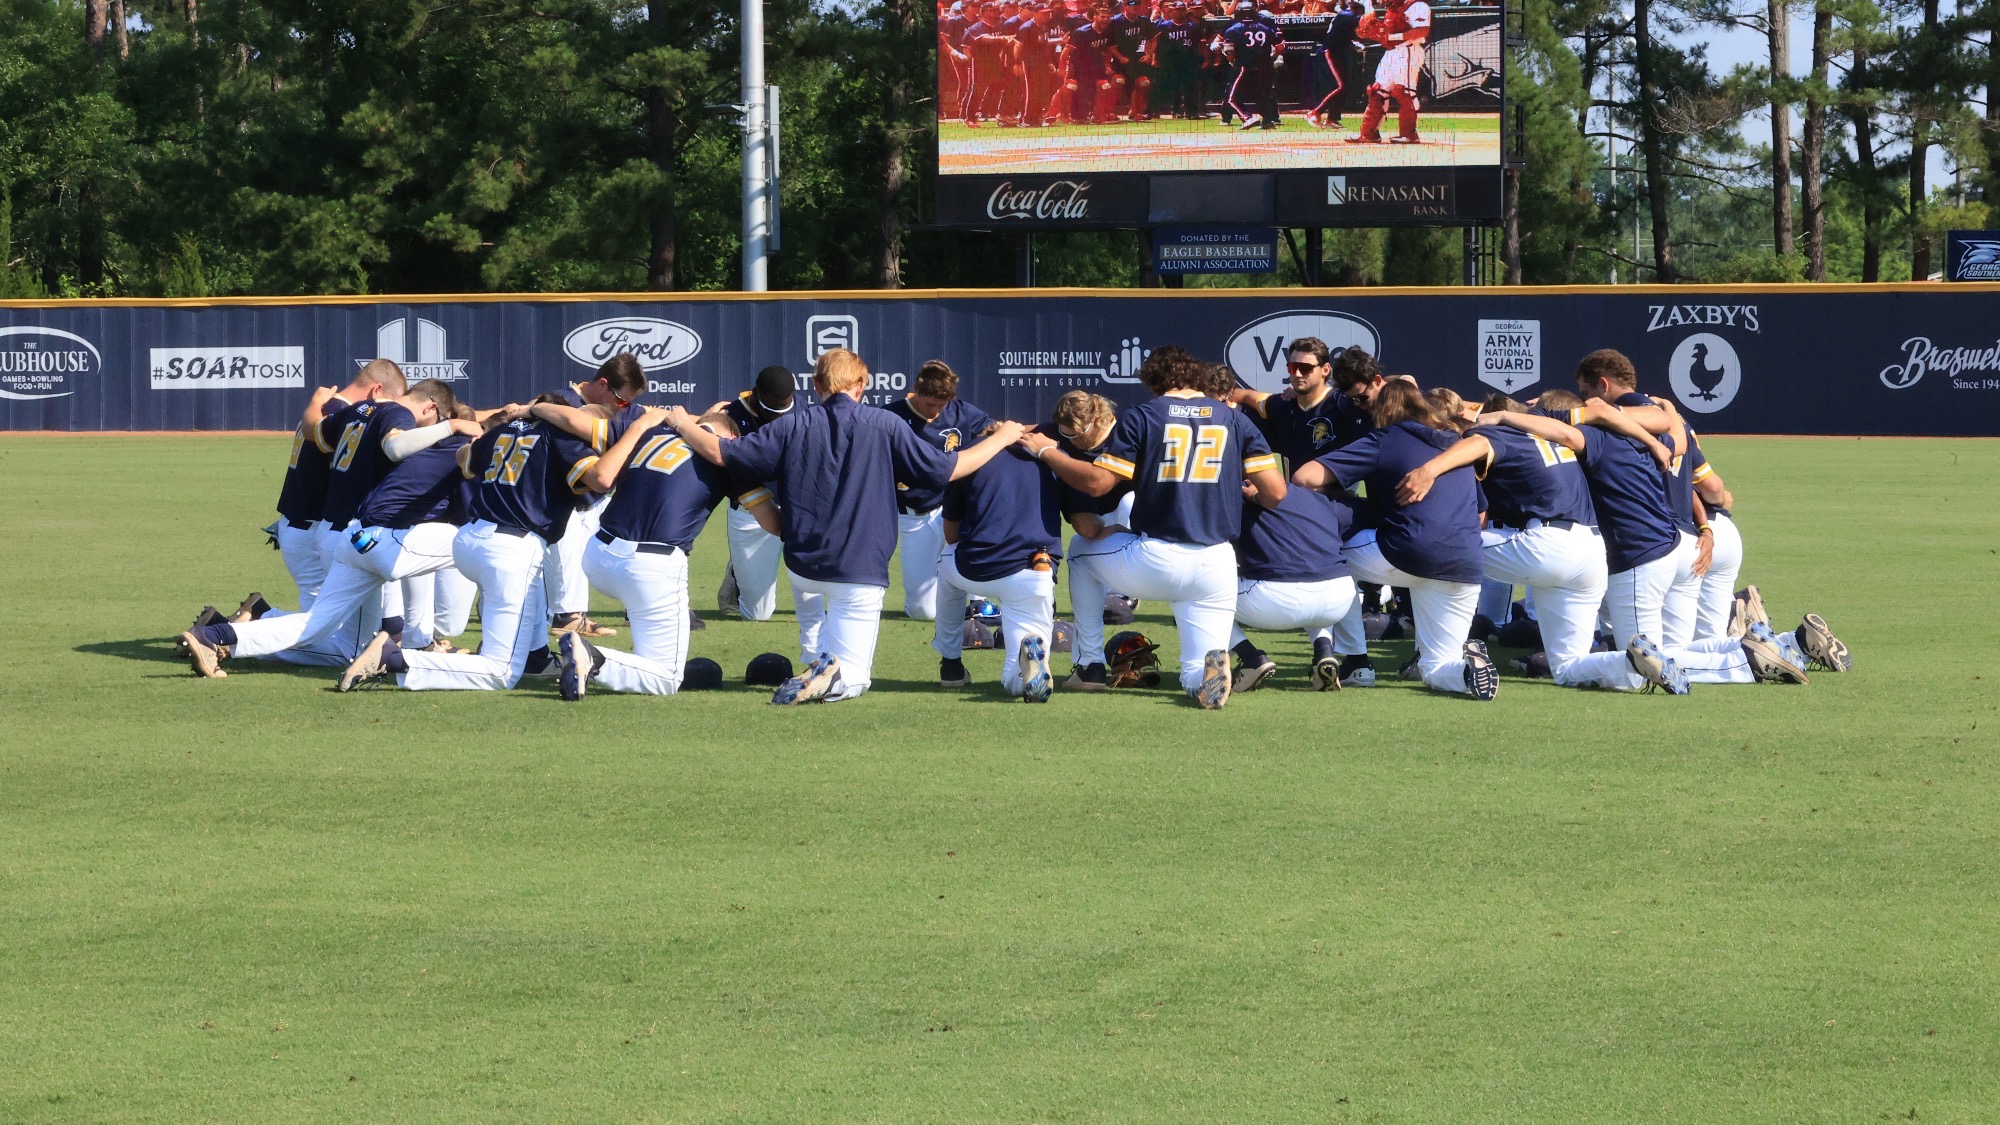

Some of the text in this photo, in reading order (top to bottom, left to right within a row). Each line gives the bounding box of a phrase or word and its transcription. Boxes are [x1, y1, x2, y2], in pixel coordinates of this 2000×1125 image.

[1244, 31, 1266, 48] 39
[987, 181, 1092, 220] Coca-Cola
[1347, 185, 1449, 202] RENASANT
[1413, 205, 1448, 216] BANK
[1180, 235, 1220, 243] DONATED
[1234, 234, 1250, 242] THE
[1163, 246, 1267, 258] EAGLE BASEBALL
[1160, 259, 1270, 270] ALUMNI ASSOCIATION
[1646, 305, 1759, 332] ZAXBY'S
[23, 342, 38, 350] THE
[591, 326, 672, 361] Ford
[1485, 334, 1533, 348] ARMY
[999, 351, 1102, 366] SOUTHERN FAMILY
[1484, 348, 1534, 357] NATIONAL
[1484, 357, 1534, 371] GUARD
[2, 375, 27, 383] GAMES
[1001, 378, 1100, 387] DENTAL GROUP
[1953, 379, 1979, 389] Since
[648, 381, 697, 394] Dealer
[1169, 405, 1213, 419] UNCG
[482, 432, 541, 487] 36
[628, 434, 694, 476] 16
[1157, 423, 1229, 484] 32
